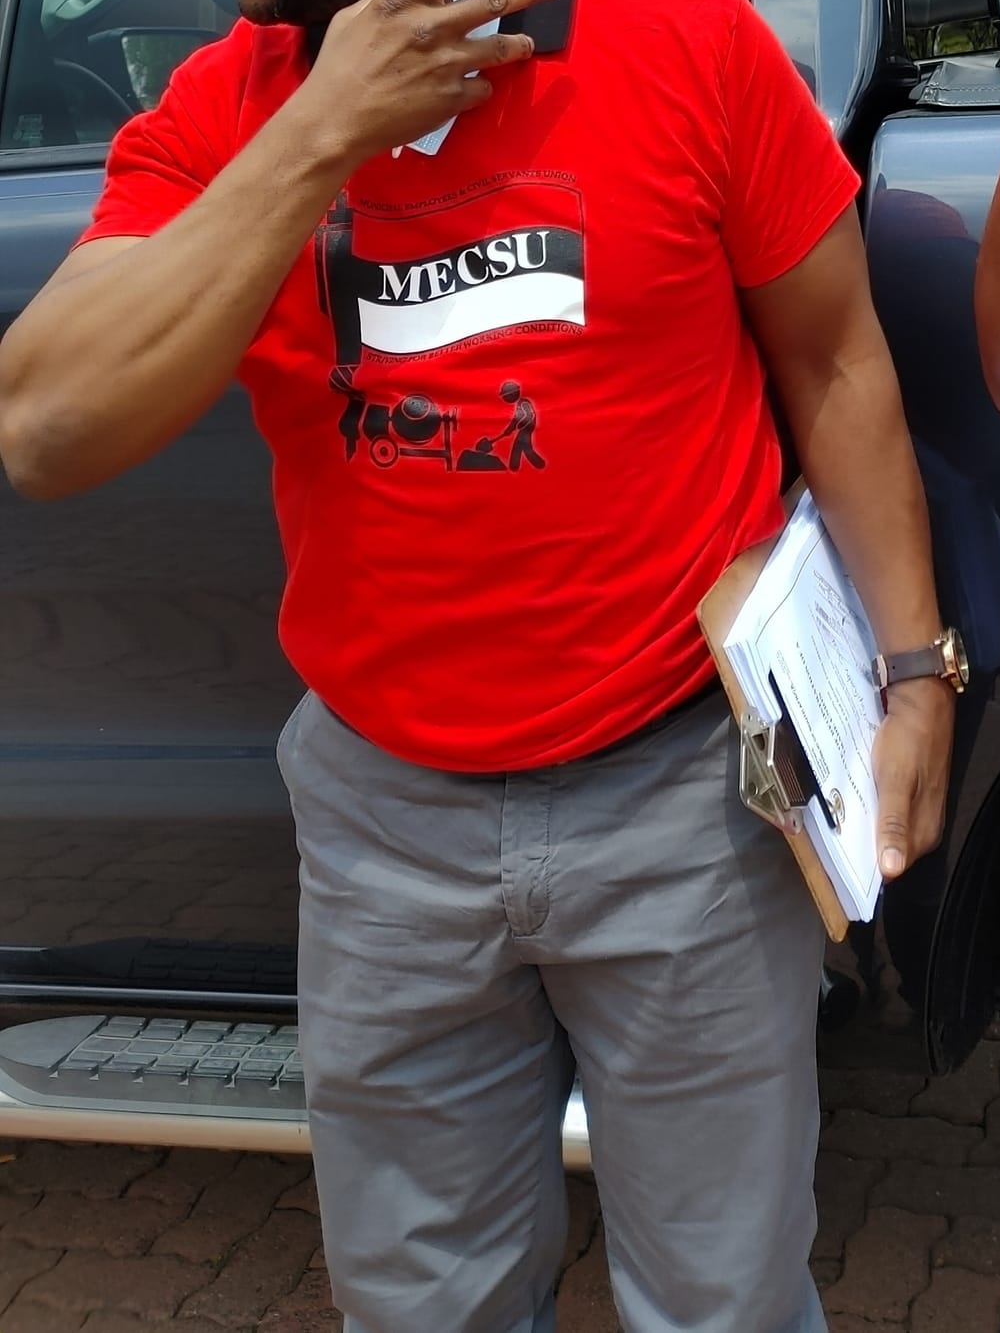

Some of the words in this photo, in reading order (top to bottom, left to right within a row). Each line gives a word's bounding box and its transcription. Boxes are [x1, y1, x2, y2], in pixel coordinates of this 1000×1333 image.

[543, 169, 577, 183] UNION
[378, 231, 550, 302] MECSU
[463, 328, 513, 350] WORKING
[514, 322, 584, 336] CONDITIONS
